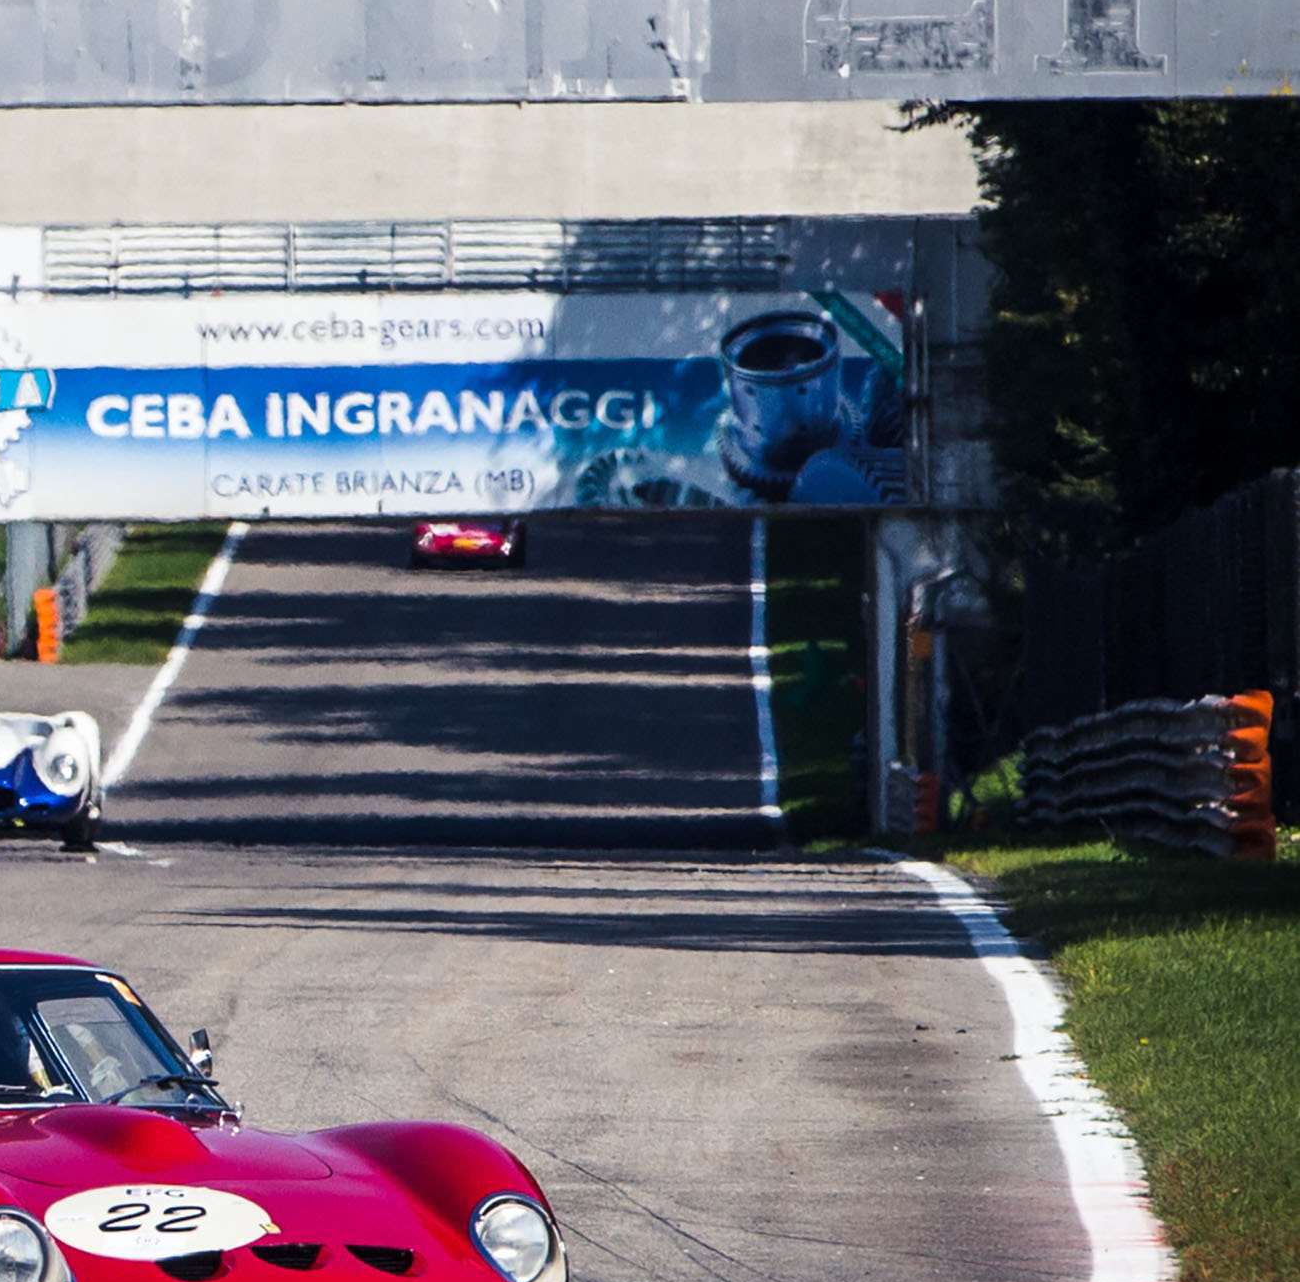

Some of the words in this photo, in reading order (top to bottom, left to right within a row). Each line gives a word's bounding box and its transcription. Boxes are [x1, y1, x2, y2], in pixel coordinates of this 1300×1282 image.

[198, 313, 545, 349] www.ceba-gears.com
[86, 393, 252, 438] CEBA
[265, 390, 656, 437] INGRANAGGI
[212, 472, 322, 496] CARATE
[336, 470, 464, 494] BRIANZA
[474, 469, 535, 500] (MB)
[98, 1203, 207, 1232] 22
